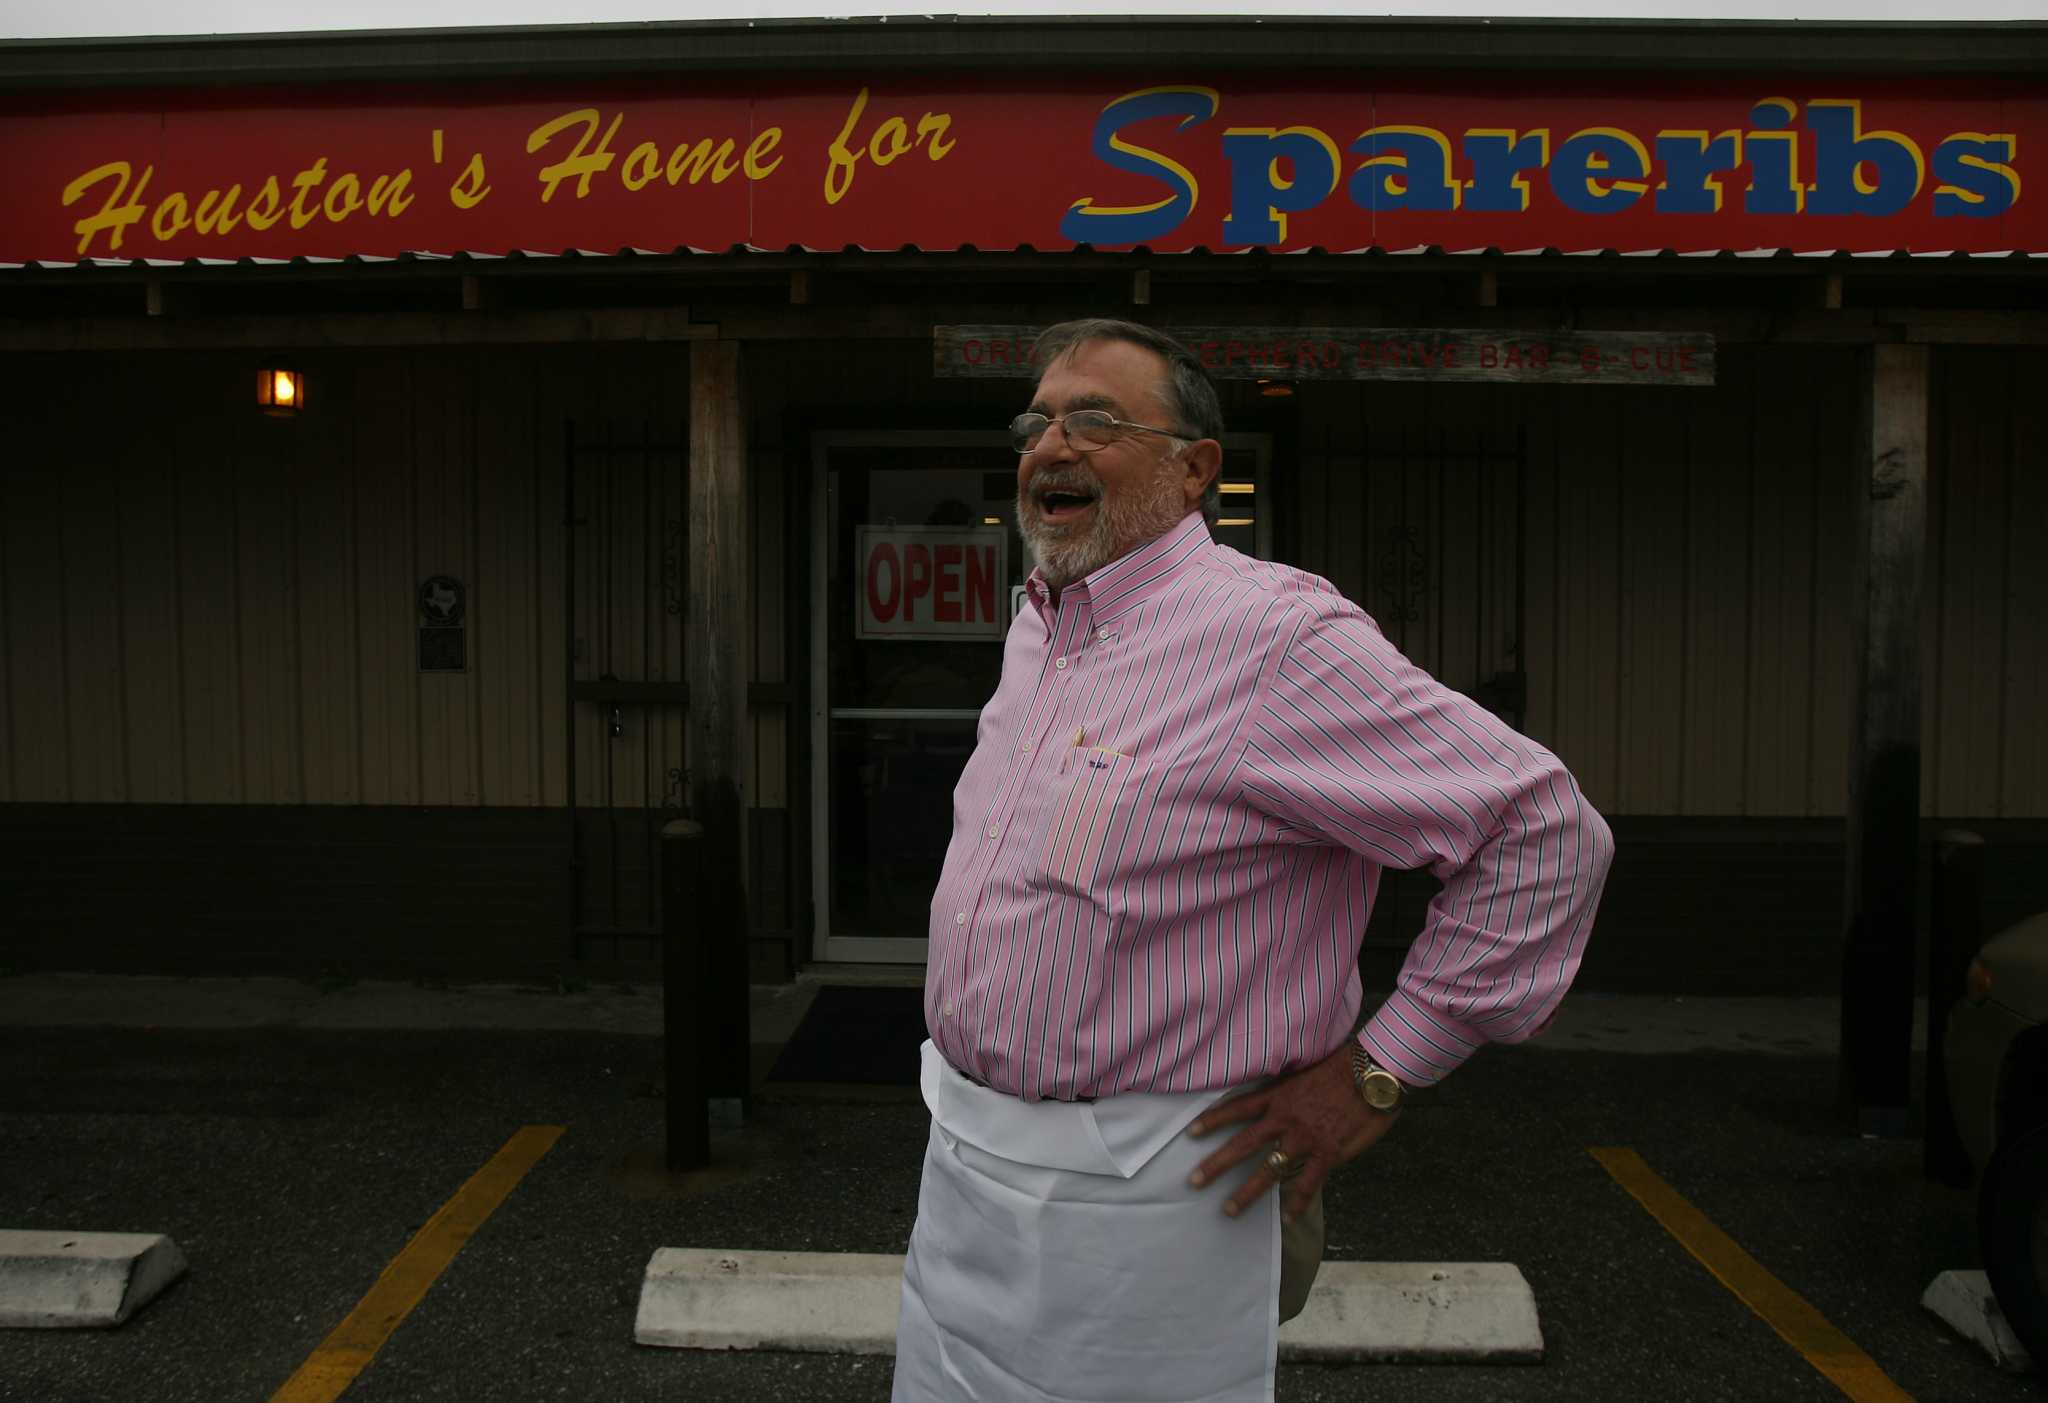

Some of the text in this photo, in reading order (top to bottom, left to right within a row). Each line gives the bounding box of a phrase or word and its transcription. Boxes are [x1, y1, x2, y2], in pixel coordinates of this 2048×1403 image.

[62, 84, 2022, 255] Houston's Home for Spareribs
[1188, 340, 1341, 369] EPHERD
[1359, 340, 1458, 369] DRIVE
[867, 542, 996, 623] OPEN
